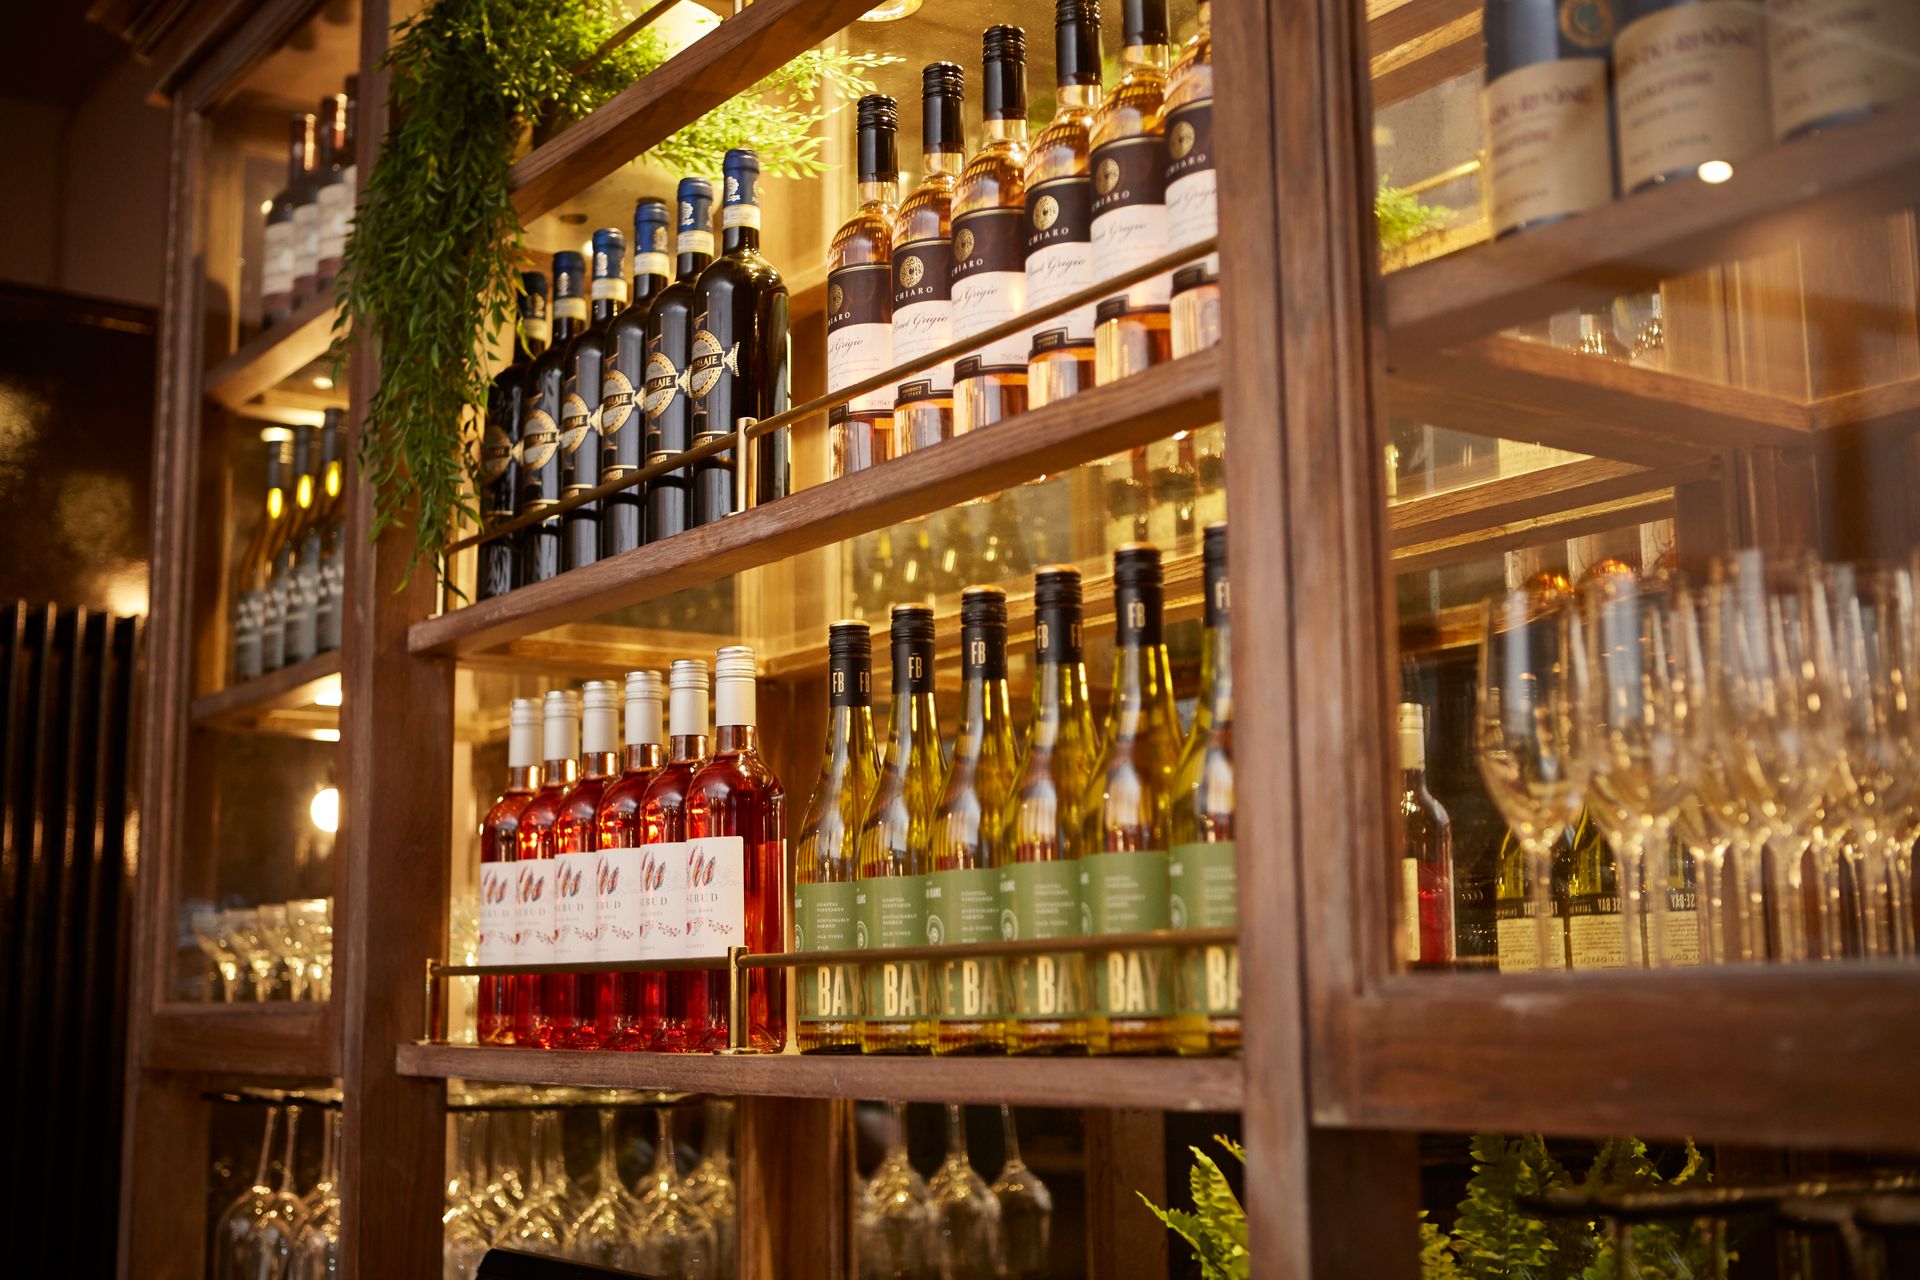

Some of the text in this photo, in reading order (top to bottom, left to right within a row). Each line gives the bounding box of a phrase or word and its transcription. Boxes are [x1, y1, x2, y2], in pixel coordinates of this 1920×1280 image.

[1029, 227, 1069, 246] CHIARO
[895, 286, 934, 302] CHIARO
[1215, 582, 1230, 609] F
[1127, 602, 1145, 629] FB
[1037, 624, 1049, 649] FB
[971, 641, 986, 665] FB
[907, 656, 923, 679] FB
[832, 671, 845, 694] FB
[859, 671, 870, 693] FB
[818, 965, 859, 1017] BAY
[884, 963, 930, 1017] BAY
[1108, 951, 1163, 1013] BAY
[1206, 946, 1241, 1012] BA
